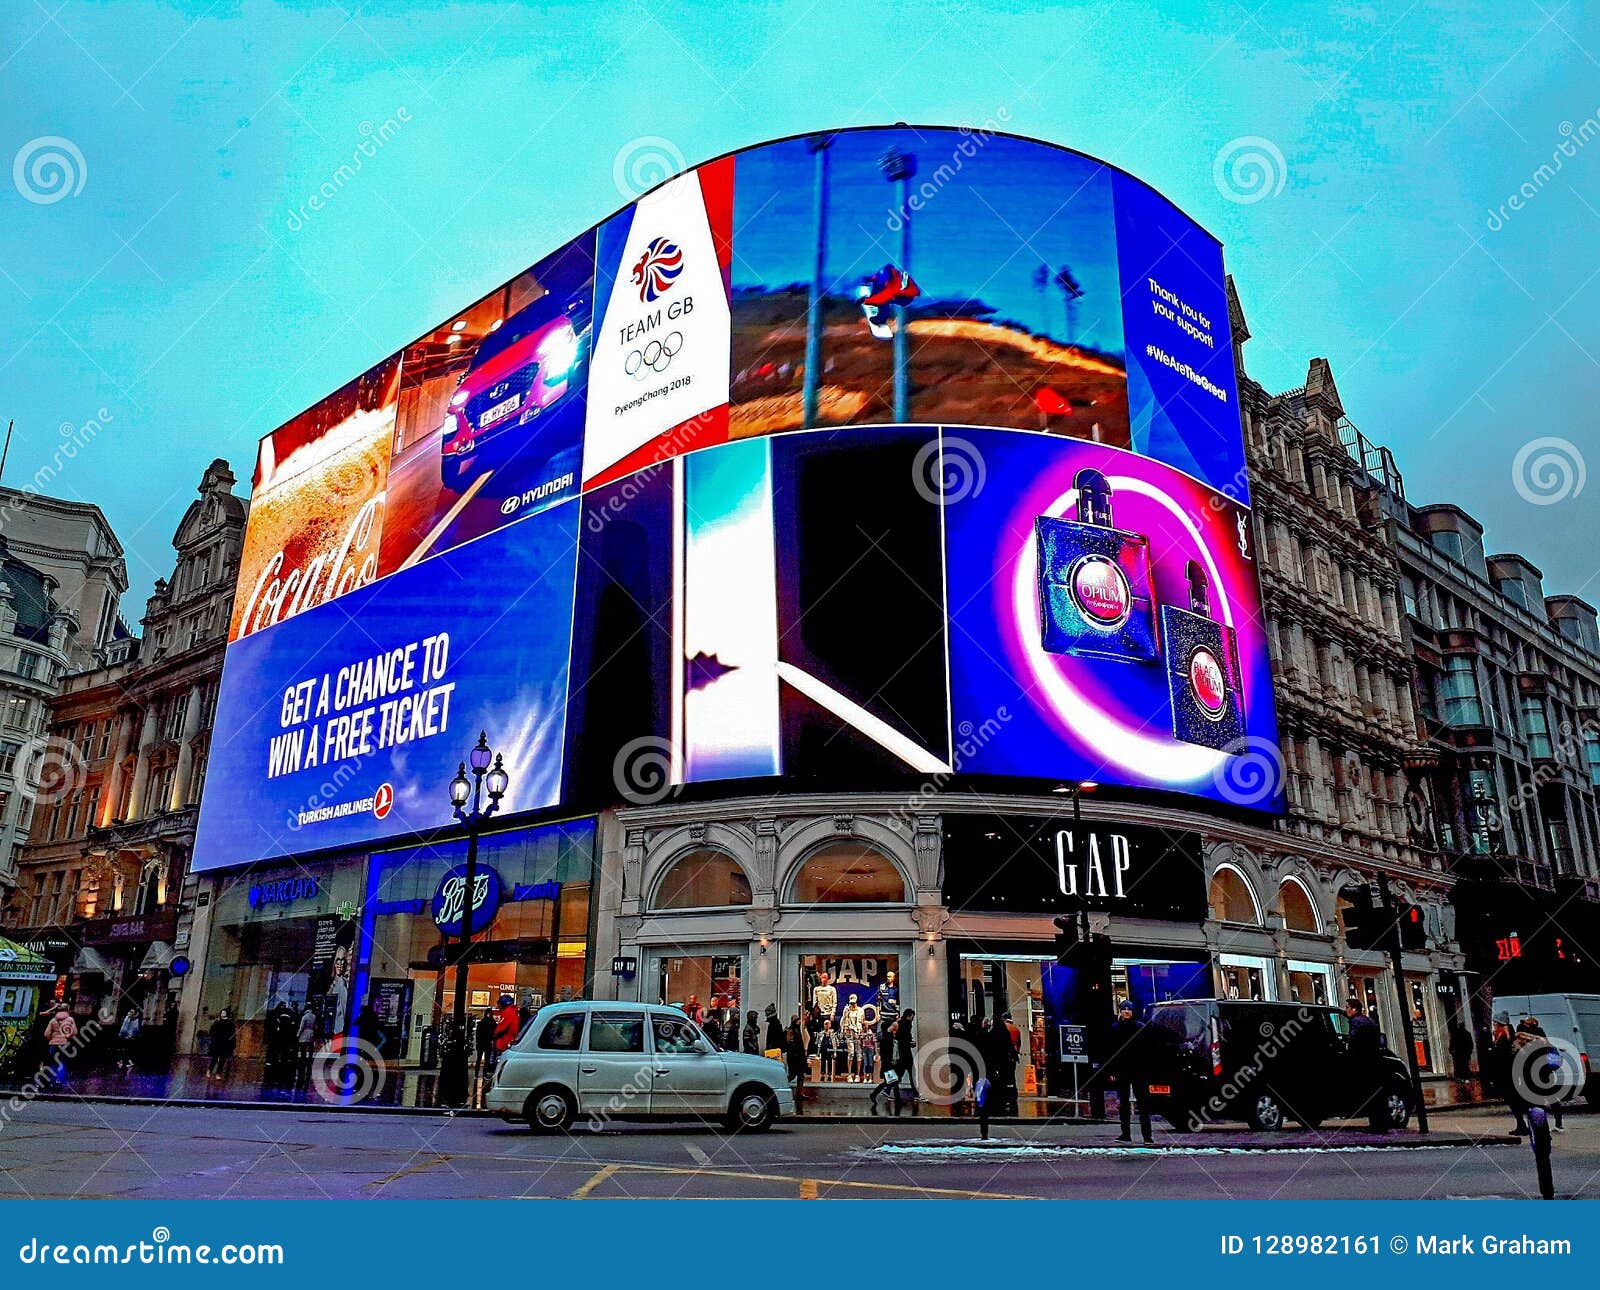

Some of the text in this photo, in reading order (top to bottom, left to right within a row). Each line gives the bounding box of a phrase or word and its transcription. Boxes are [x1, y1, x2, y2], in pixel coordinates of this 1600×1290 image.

[620, 296, 694, 345] TEAM GB
[1148, 278, 1210, 330] Thank you for
[1152, 300, 1214, 348] your support!
[614, 375, 691, 415] PyeongChang 2018
[1146, 344, 1227, 403] #WeAreTheGreat
[522, 472, 574, 506] HYUNDAI
[1081, 584, 1123, 604] OPIUM
[280, 631, 450, 728] GET A CHANCE TO
[268, 682, 456, 779] WIN A FREE TICKET
[297, 798, 374, 826] TURKISH AIRLINES
[1055, 830, 1131, 898] GAP
[261, 877, 318, 903] BARCLAYS
[435, 873, 490, 924] Bots
[821, 958, 878, 987] GAP
